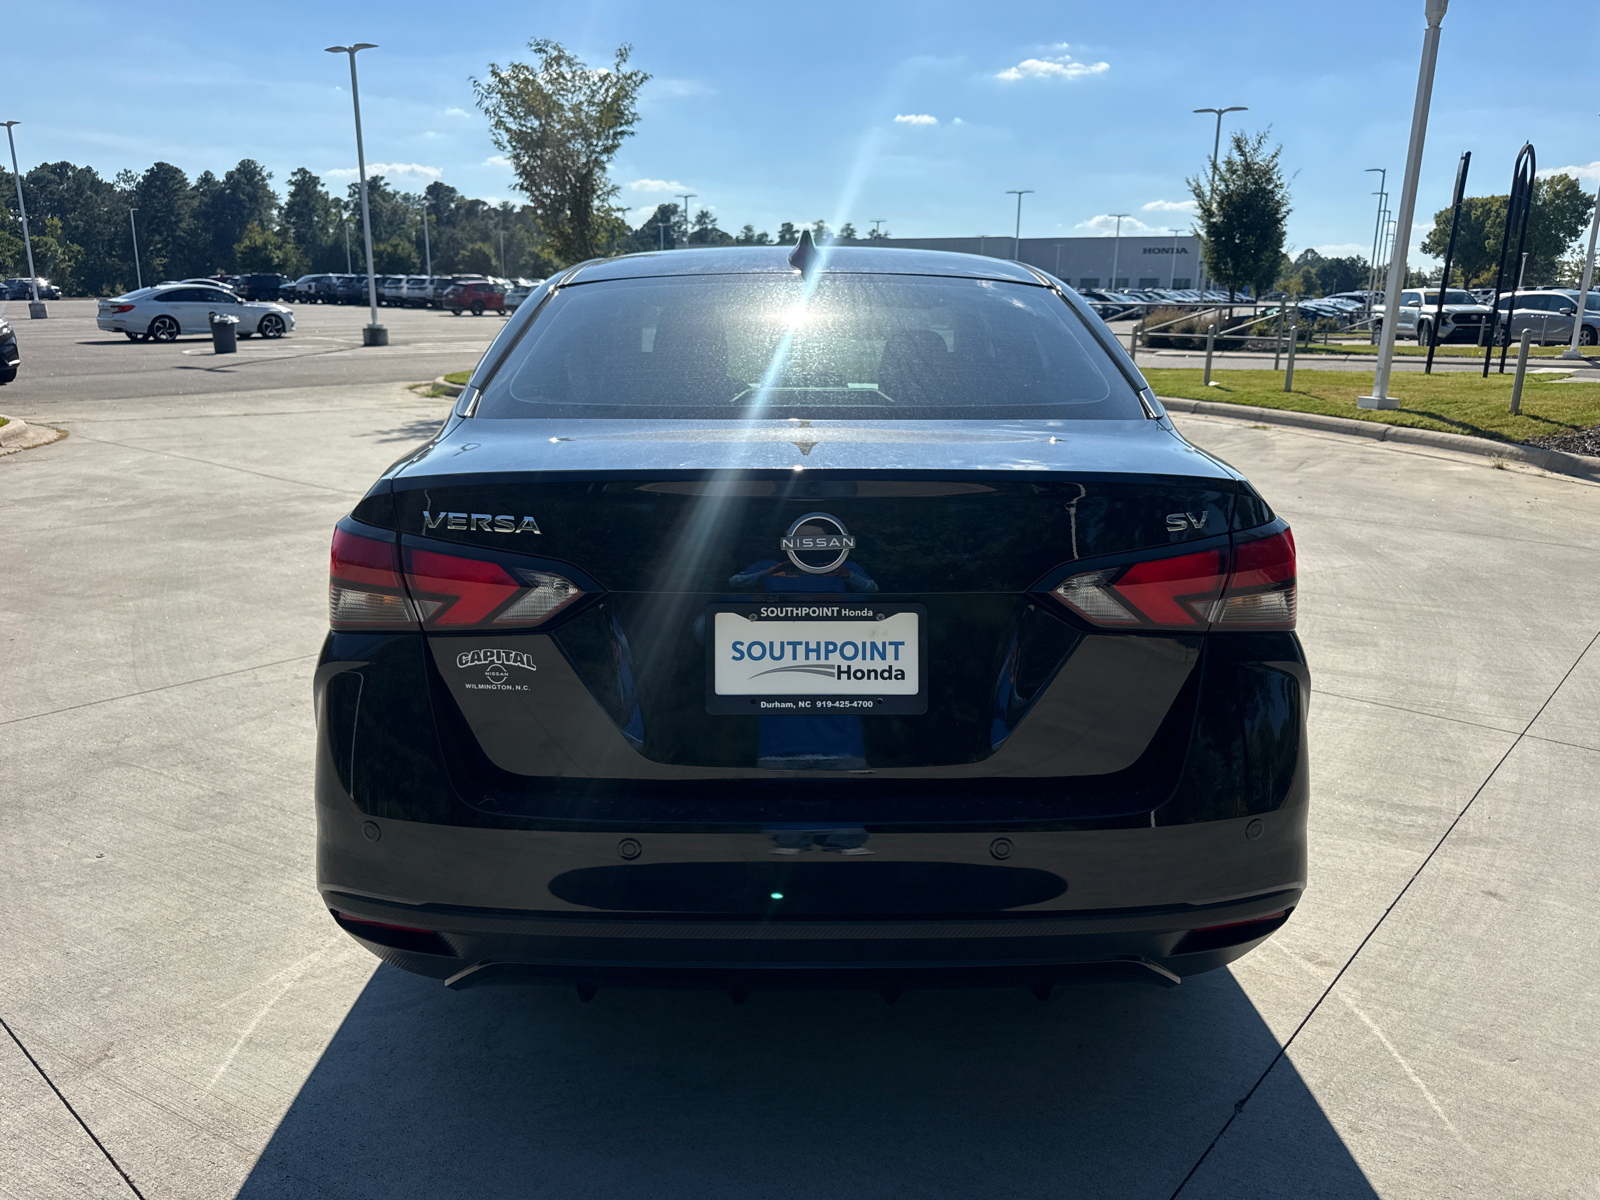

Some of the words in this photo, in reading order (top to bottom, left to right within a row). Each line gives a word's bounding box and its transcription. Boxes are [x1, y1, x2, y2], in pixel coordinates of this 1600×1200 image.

[423, 510, 542, 535] VERSA
[1166, 511, 1209, 532] SV
[782, 537, 854, 548] NISSAN
[760, 607, 839, 617] SOUTHPOINT
[841, 608, 873, 617] Honda
[456, 648, 537, 671] CAPITAL
[731, 640, 905, 661] SOUTHPOINT
[836, 664, 906, 681] Honda
[760, 701, 796, 709] Durham,
[816, 700, 873, 708] 919-425-4700
